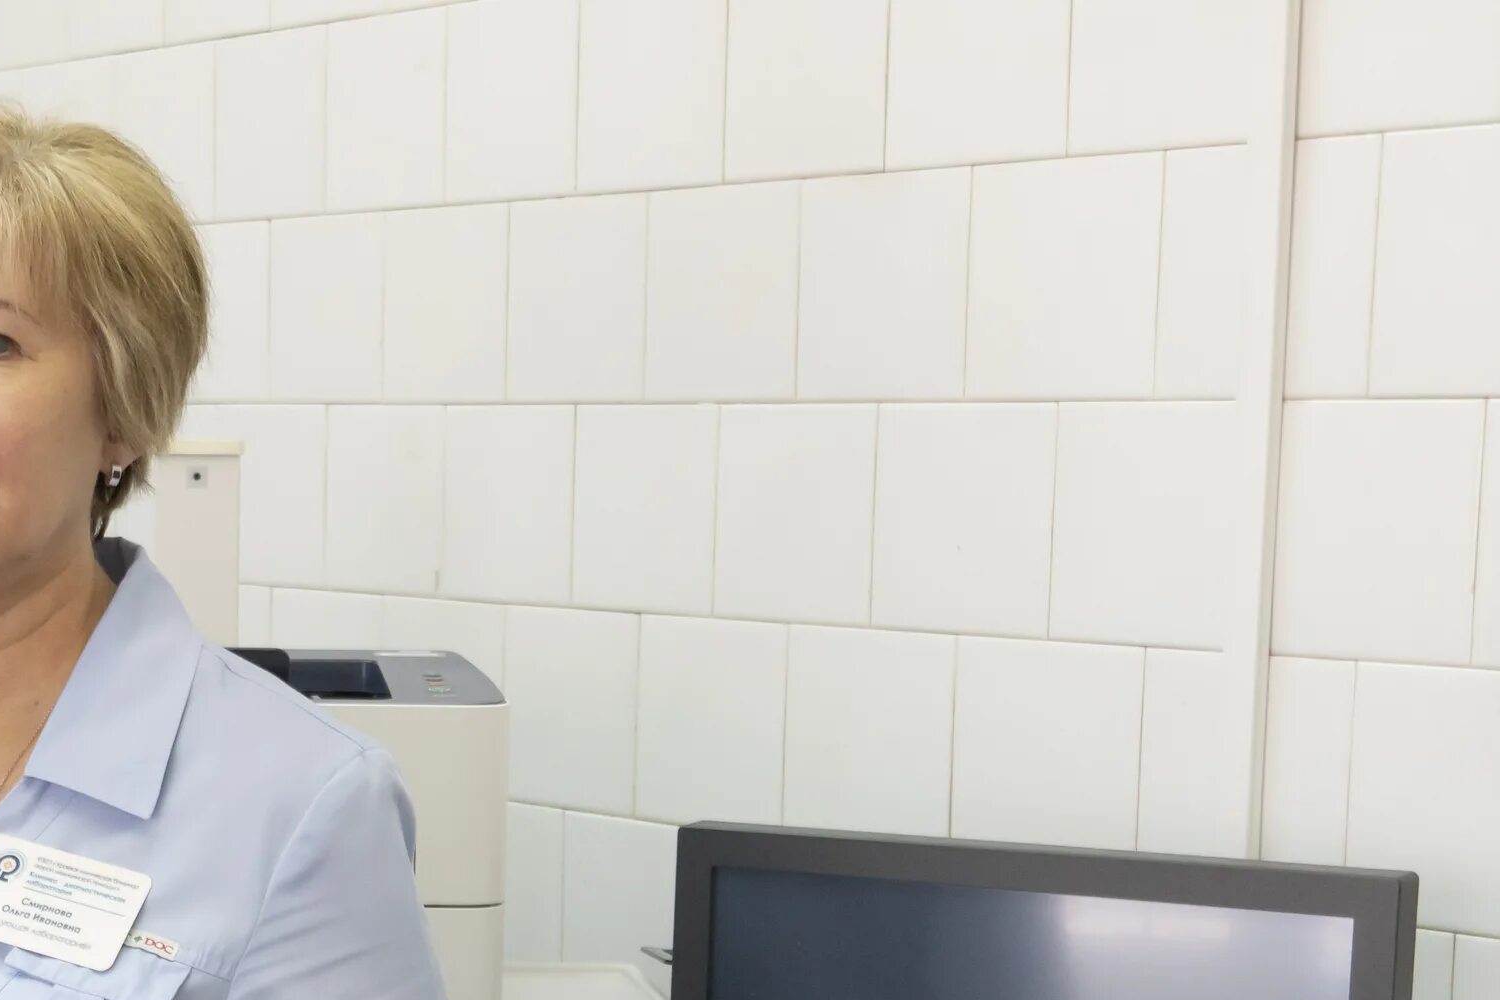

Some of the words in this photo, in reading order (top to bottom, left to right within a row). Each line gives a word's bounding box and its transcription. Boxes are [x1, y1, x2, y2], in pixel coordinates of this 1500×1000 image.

[21, 897, 73, 919] Смирнова
[1, 904, 31, 920] Ольга
[32, 912, 82, 935] Ивановна
[144, 937, 175, 955] DOC
